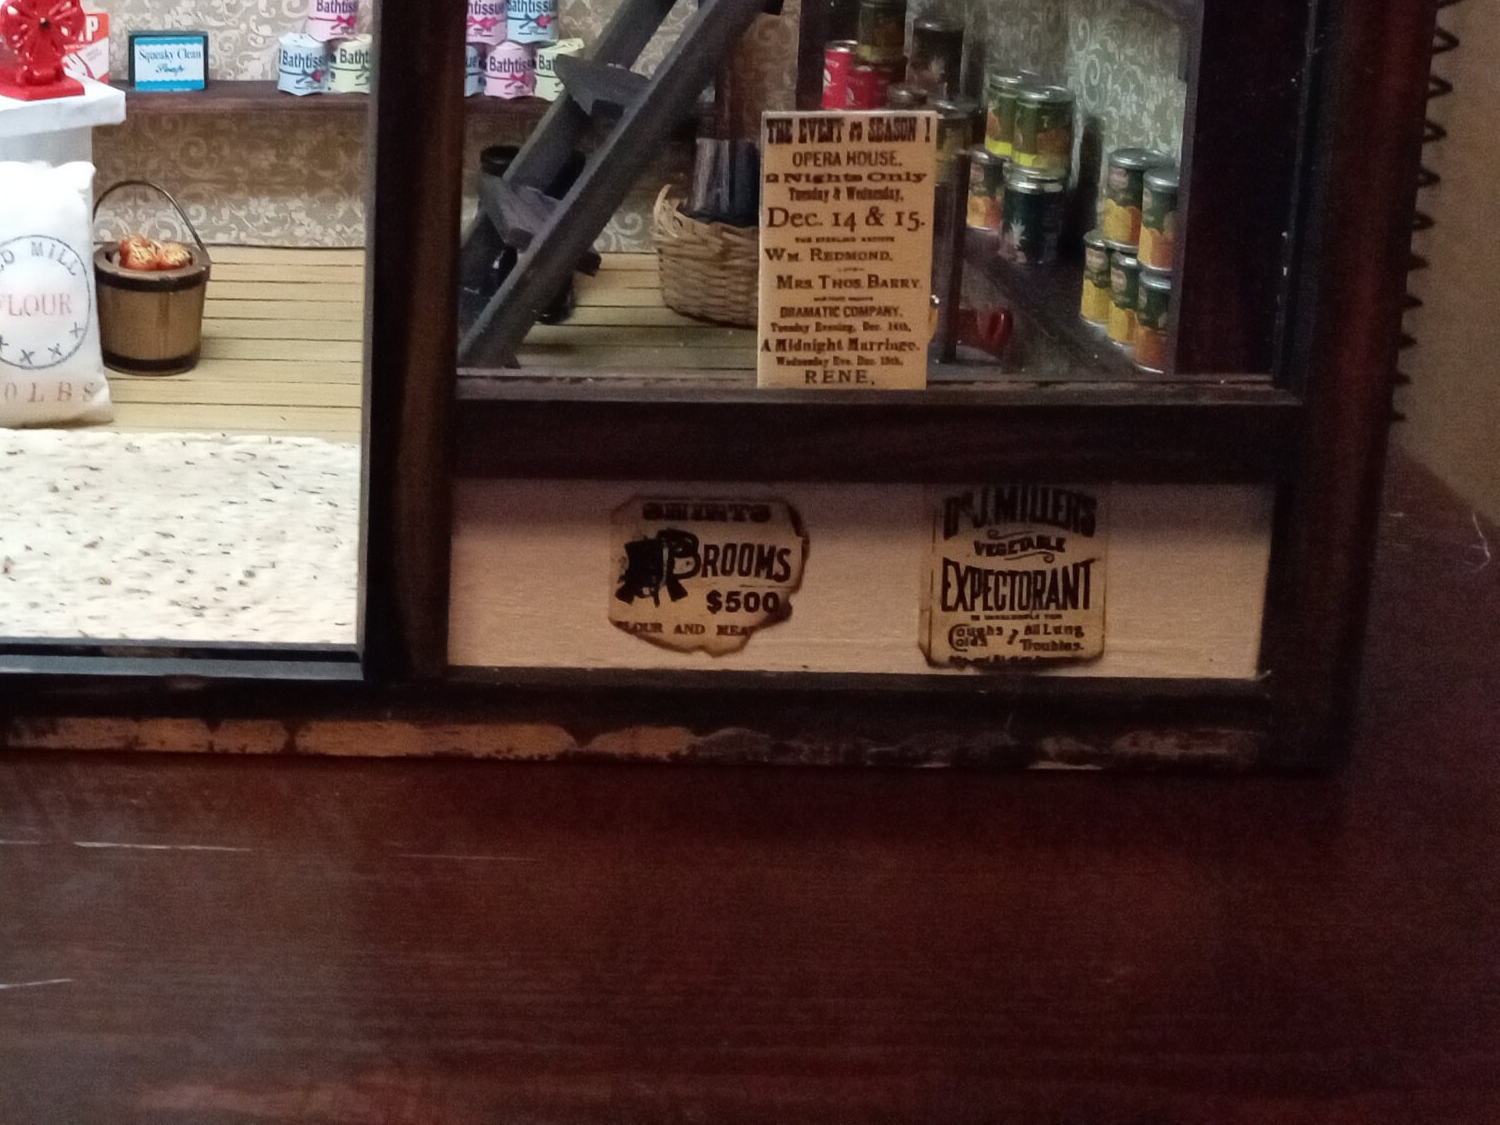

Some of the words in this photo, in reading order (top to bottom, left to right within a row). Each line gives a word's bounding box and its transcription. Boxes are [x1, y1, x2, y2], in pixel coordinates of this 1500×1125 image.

[766, 118, 793, 144] THE
[798, 117, 844, 144] EVENT
[868, 117, 917, 143] SEASON
[792, 151, 842, 167] OPERA
[846, 150, 902, 167] HOUSE.
[784, 173, 863, 184] Nights
[867, 172, 927, 183] Only
[789, 187, 829, 203] Tuesday
[767, 207, 823, 228] Dec.
[832, 212, 857, 232] 14
[865, 206, 884, 227] &
[895, 211, 925, 232] 15.
[780, 306, 840, 318] DRAMATIC
[761, 339, 771, 352] A
[775, 338, 844, 354] Midnight
[973, 535, 1066, 557] VEGETABLE
[941, 557, 1096, 612] EXPECTORANT
[706, 589, 781, 614] $500
[674, 623, 705, 635] AND
